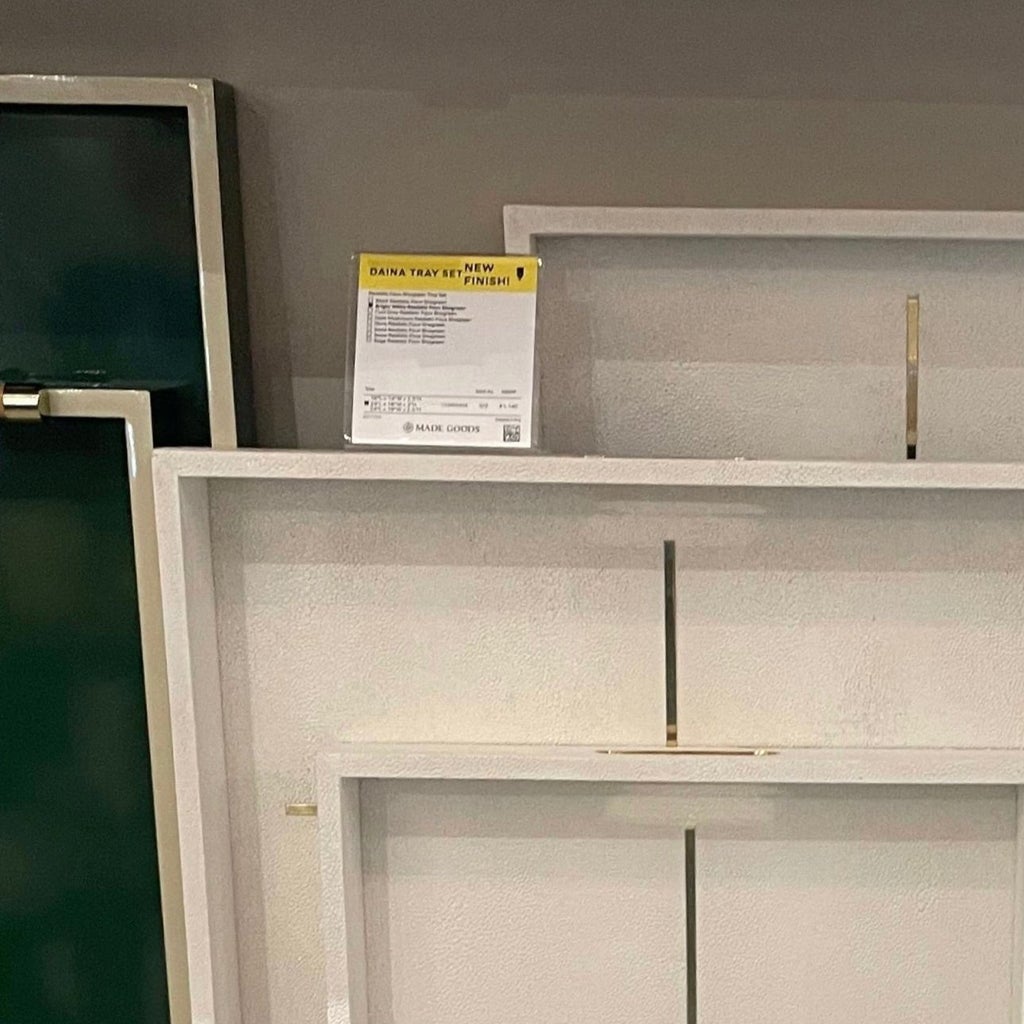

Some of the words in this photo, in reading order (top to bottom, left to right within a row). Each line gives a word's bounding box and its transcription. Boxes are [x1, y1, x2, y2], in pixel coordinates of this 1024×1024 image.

[370, 267, 406, 277] DAINA
[410, 268, 439, 277] TRAY
[442, 268, 462, 278] SET
[464, 263, 494, 272] NEW
[463, 276, 510, 286] FINISH!
[415, 423, 444, 433] MADE
[446, 424, 480, 433] GOODS
